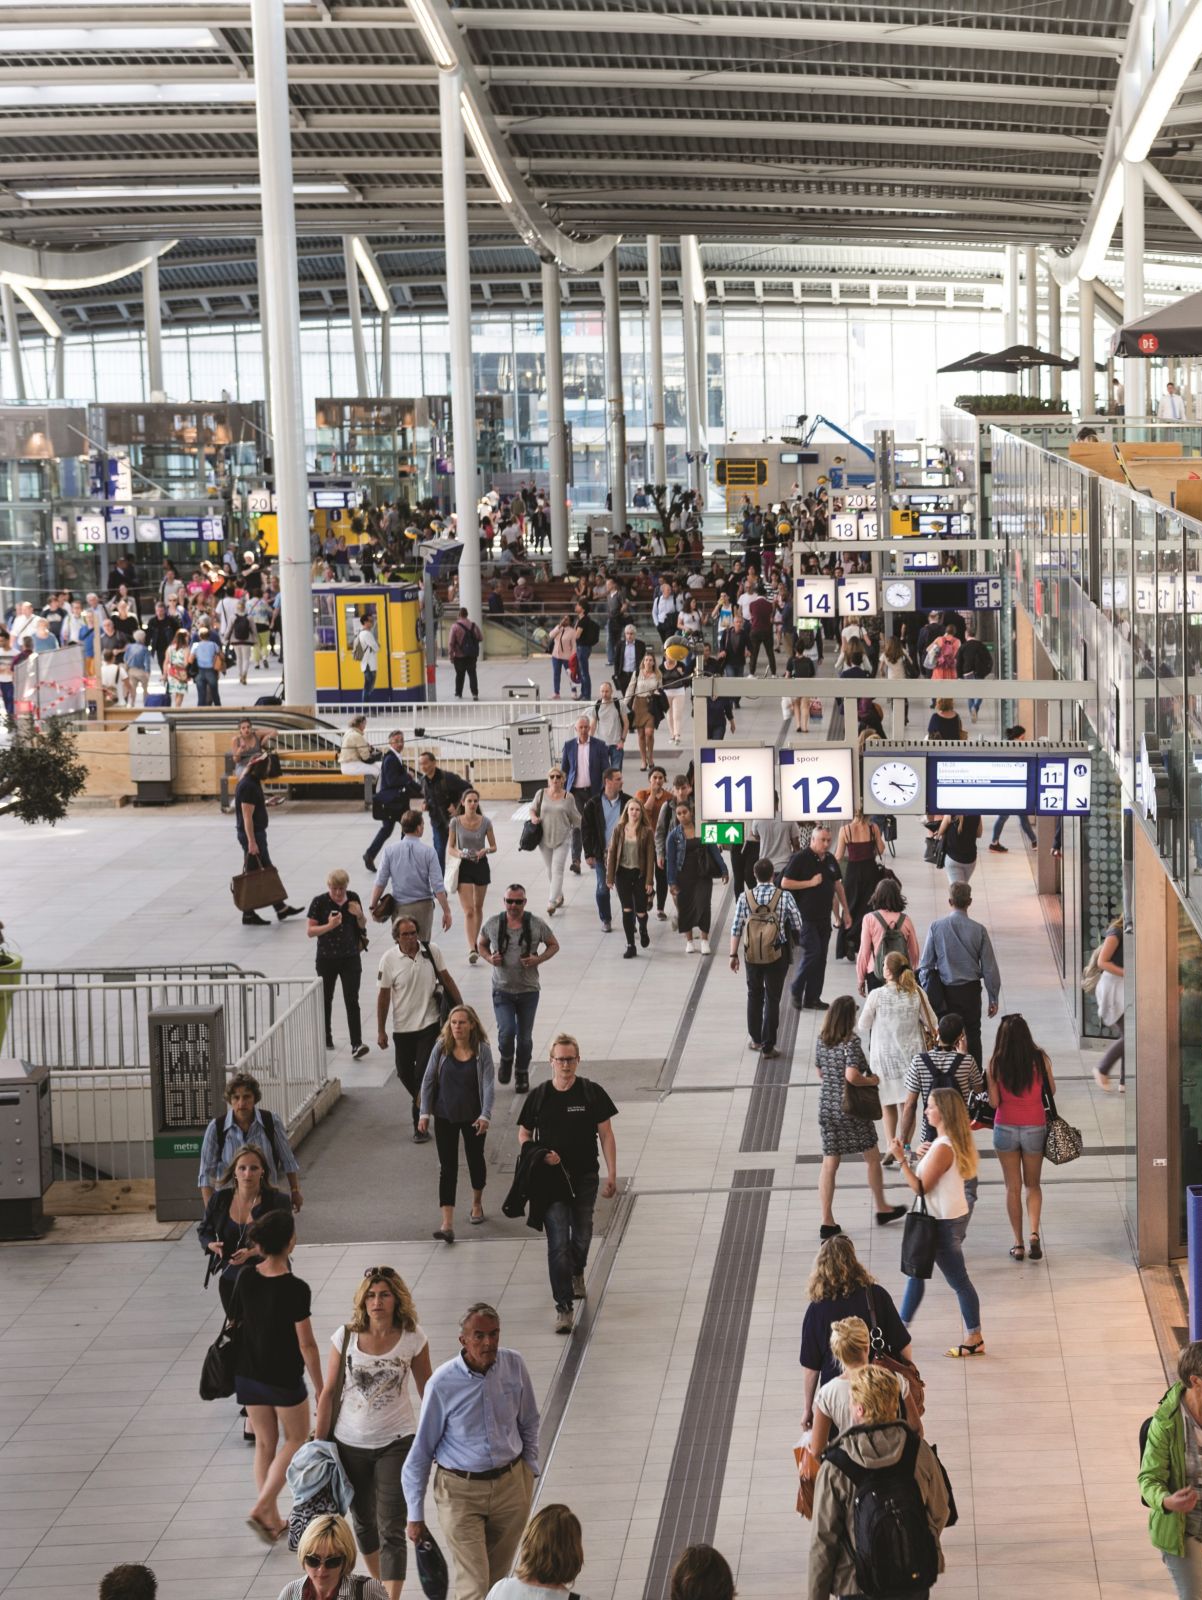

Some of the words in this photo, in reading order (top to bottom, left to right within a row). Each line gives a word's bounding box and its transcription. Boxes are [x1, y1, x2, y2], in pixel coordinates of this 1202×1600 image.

[84, 526, 100, 539] 18
[112, 526, 130, 540] 19
[835, 523, 853, 537] 18
[803, 593, 831, 613] 14
[845, 591, 870, 612] 15
[717, 754, 741, 762] spoor
[796, 756, 819, 764] spoor
[714, 775, 753, 813] 11
[792, 775, 842, 814] 12
[173, 1142, 200, 1151] metro
